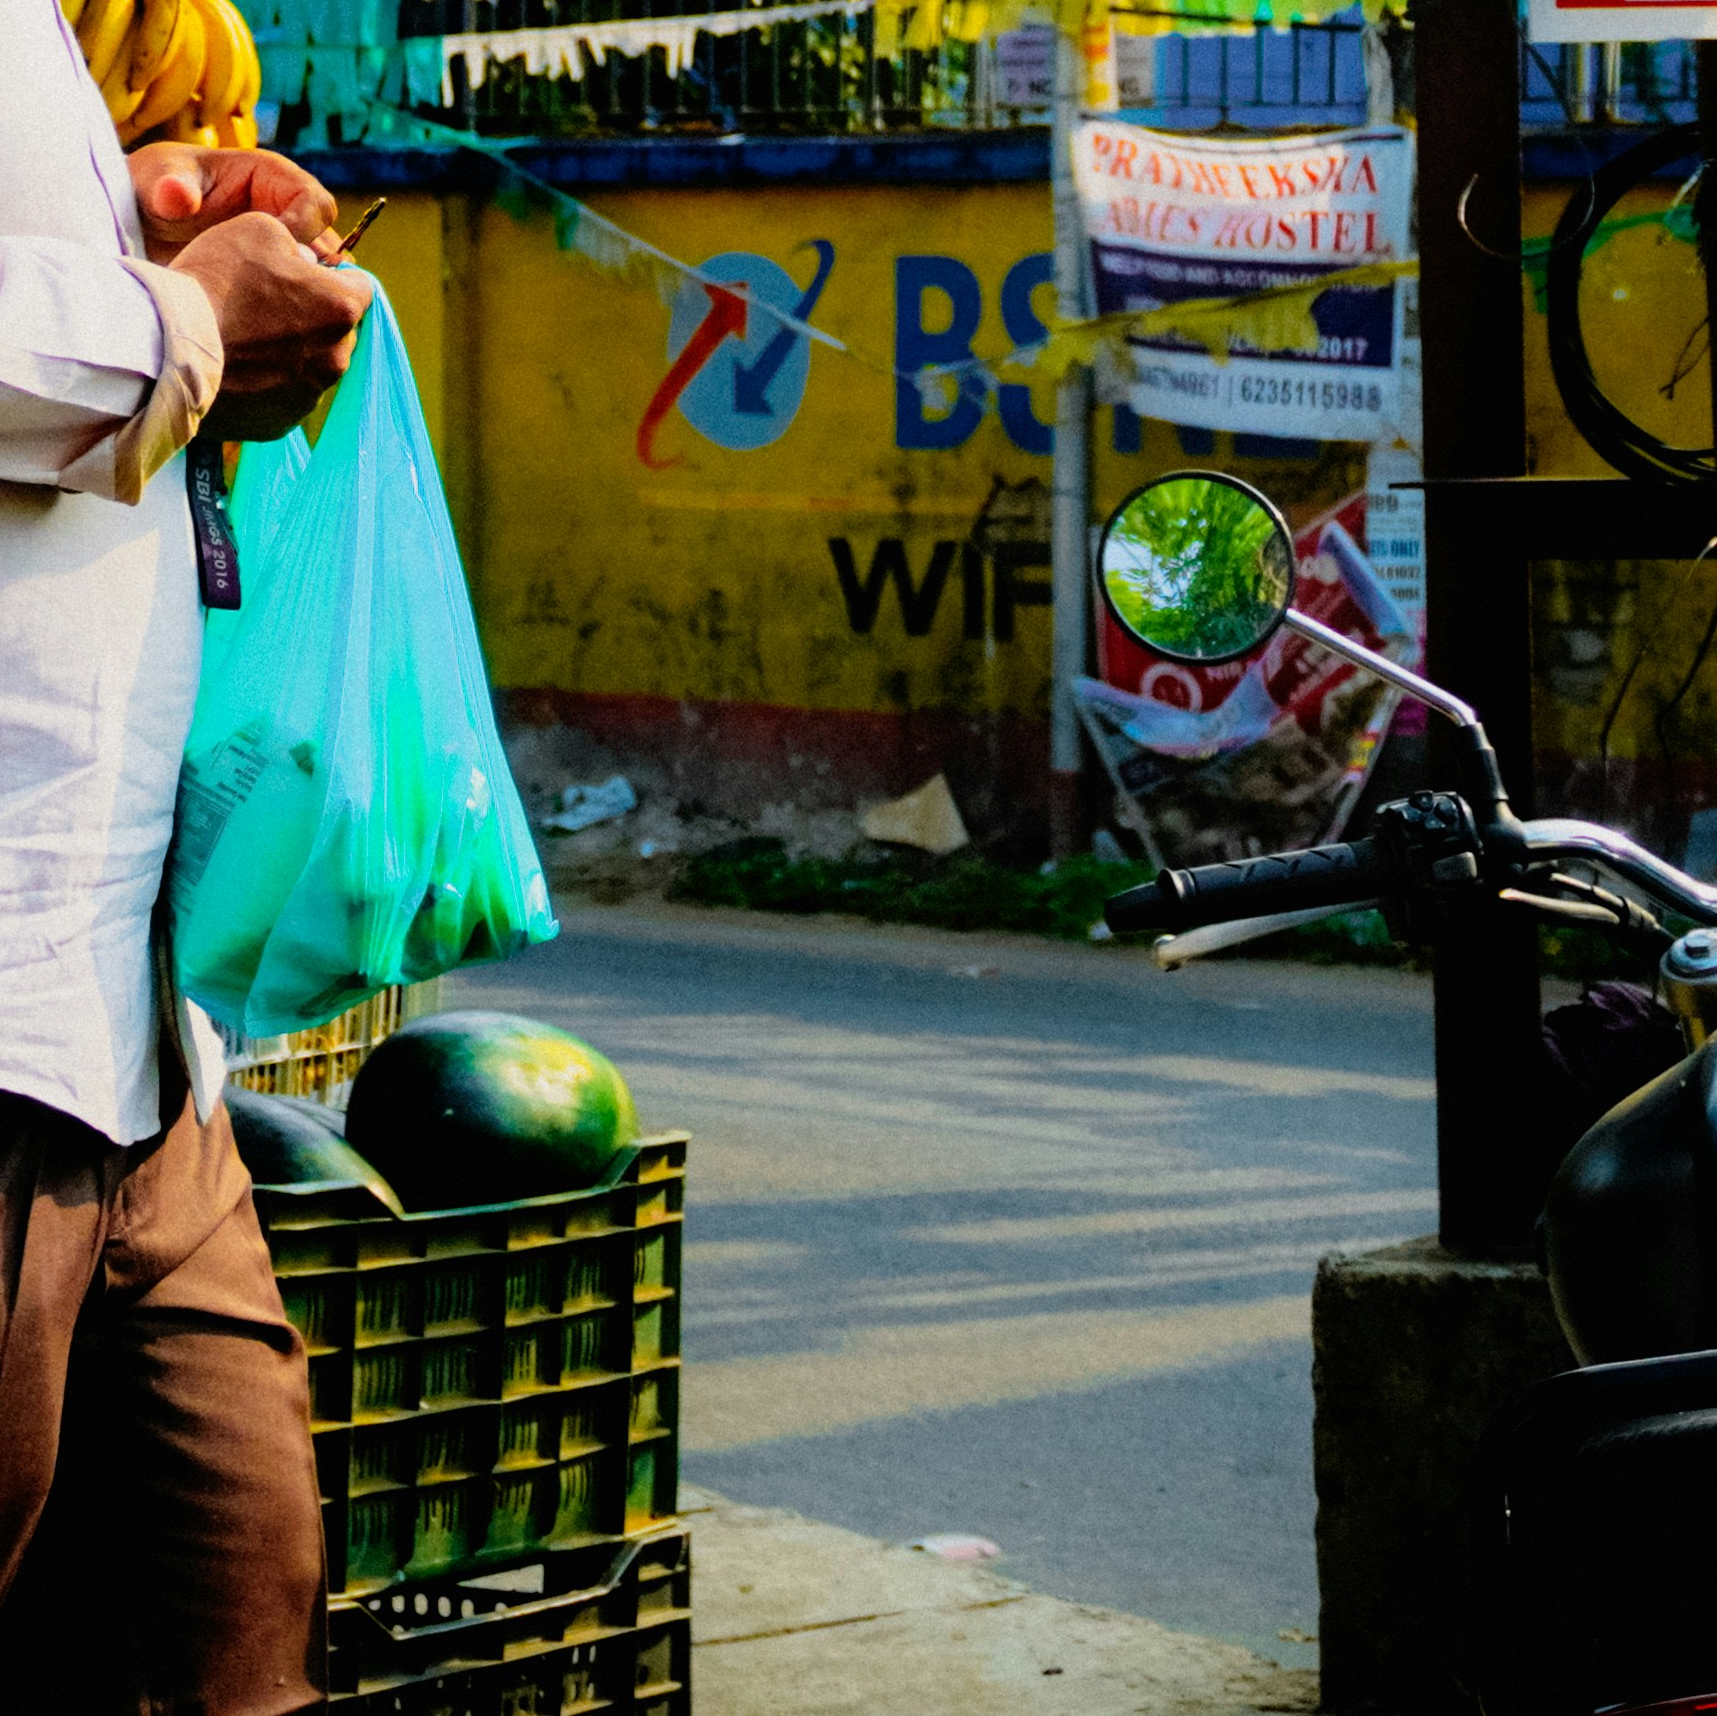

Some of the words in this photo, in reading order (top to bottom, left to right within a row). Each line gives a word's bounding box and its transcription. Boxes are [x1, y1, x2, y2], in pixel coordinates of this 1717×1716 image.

[1213, 207, 1394, 255] HOSTEL
[195, 468, 211, 502] SBI
[213, 550, 229, 589] 2016
[827, 536, 1054, 642] WIF
